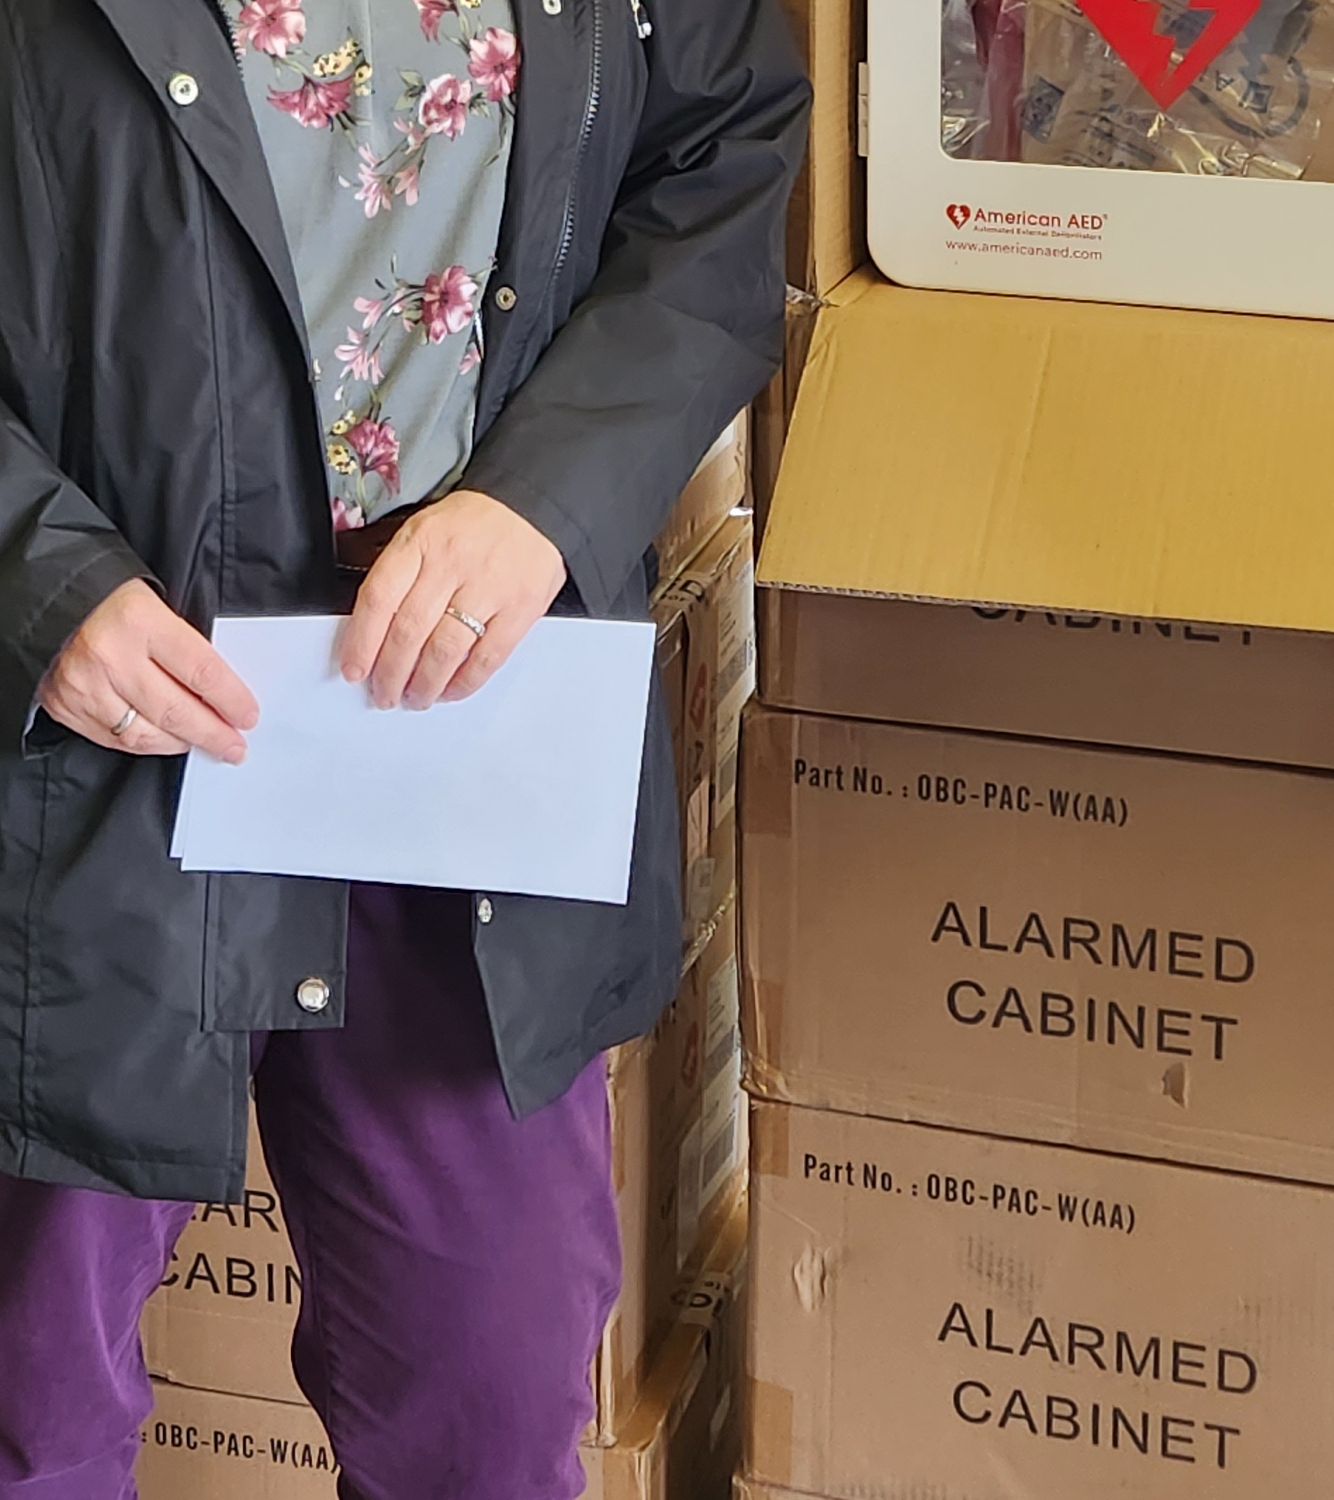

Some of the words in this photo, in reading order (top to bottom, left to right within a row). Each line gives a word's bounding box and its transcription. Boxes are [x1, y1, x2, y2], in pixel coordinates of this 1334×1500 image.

[974, 208, 1061, 228] American
[946, 240, 1102, 260] www.americanaed.com
[794, 758, 844, 791] Part
[931, 901, 1255, 984] ALARMED
[947, 979, 1239, 1062] CABINET
[804, 1153, 854, 1187] Part
[159, 1251, 303, 1305] CABIN
[937, 1301, 1258, 1394] ALARMED
[952, 1379, 1241, 1469] CABINET
